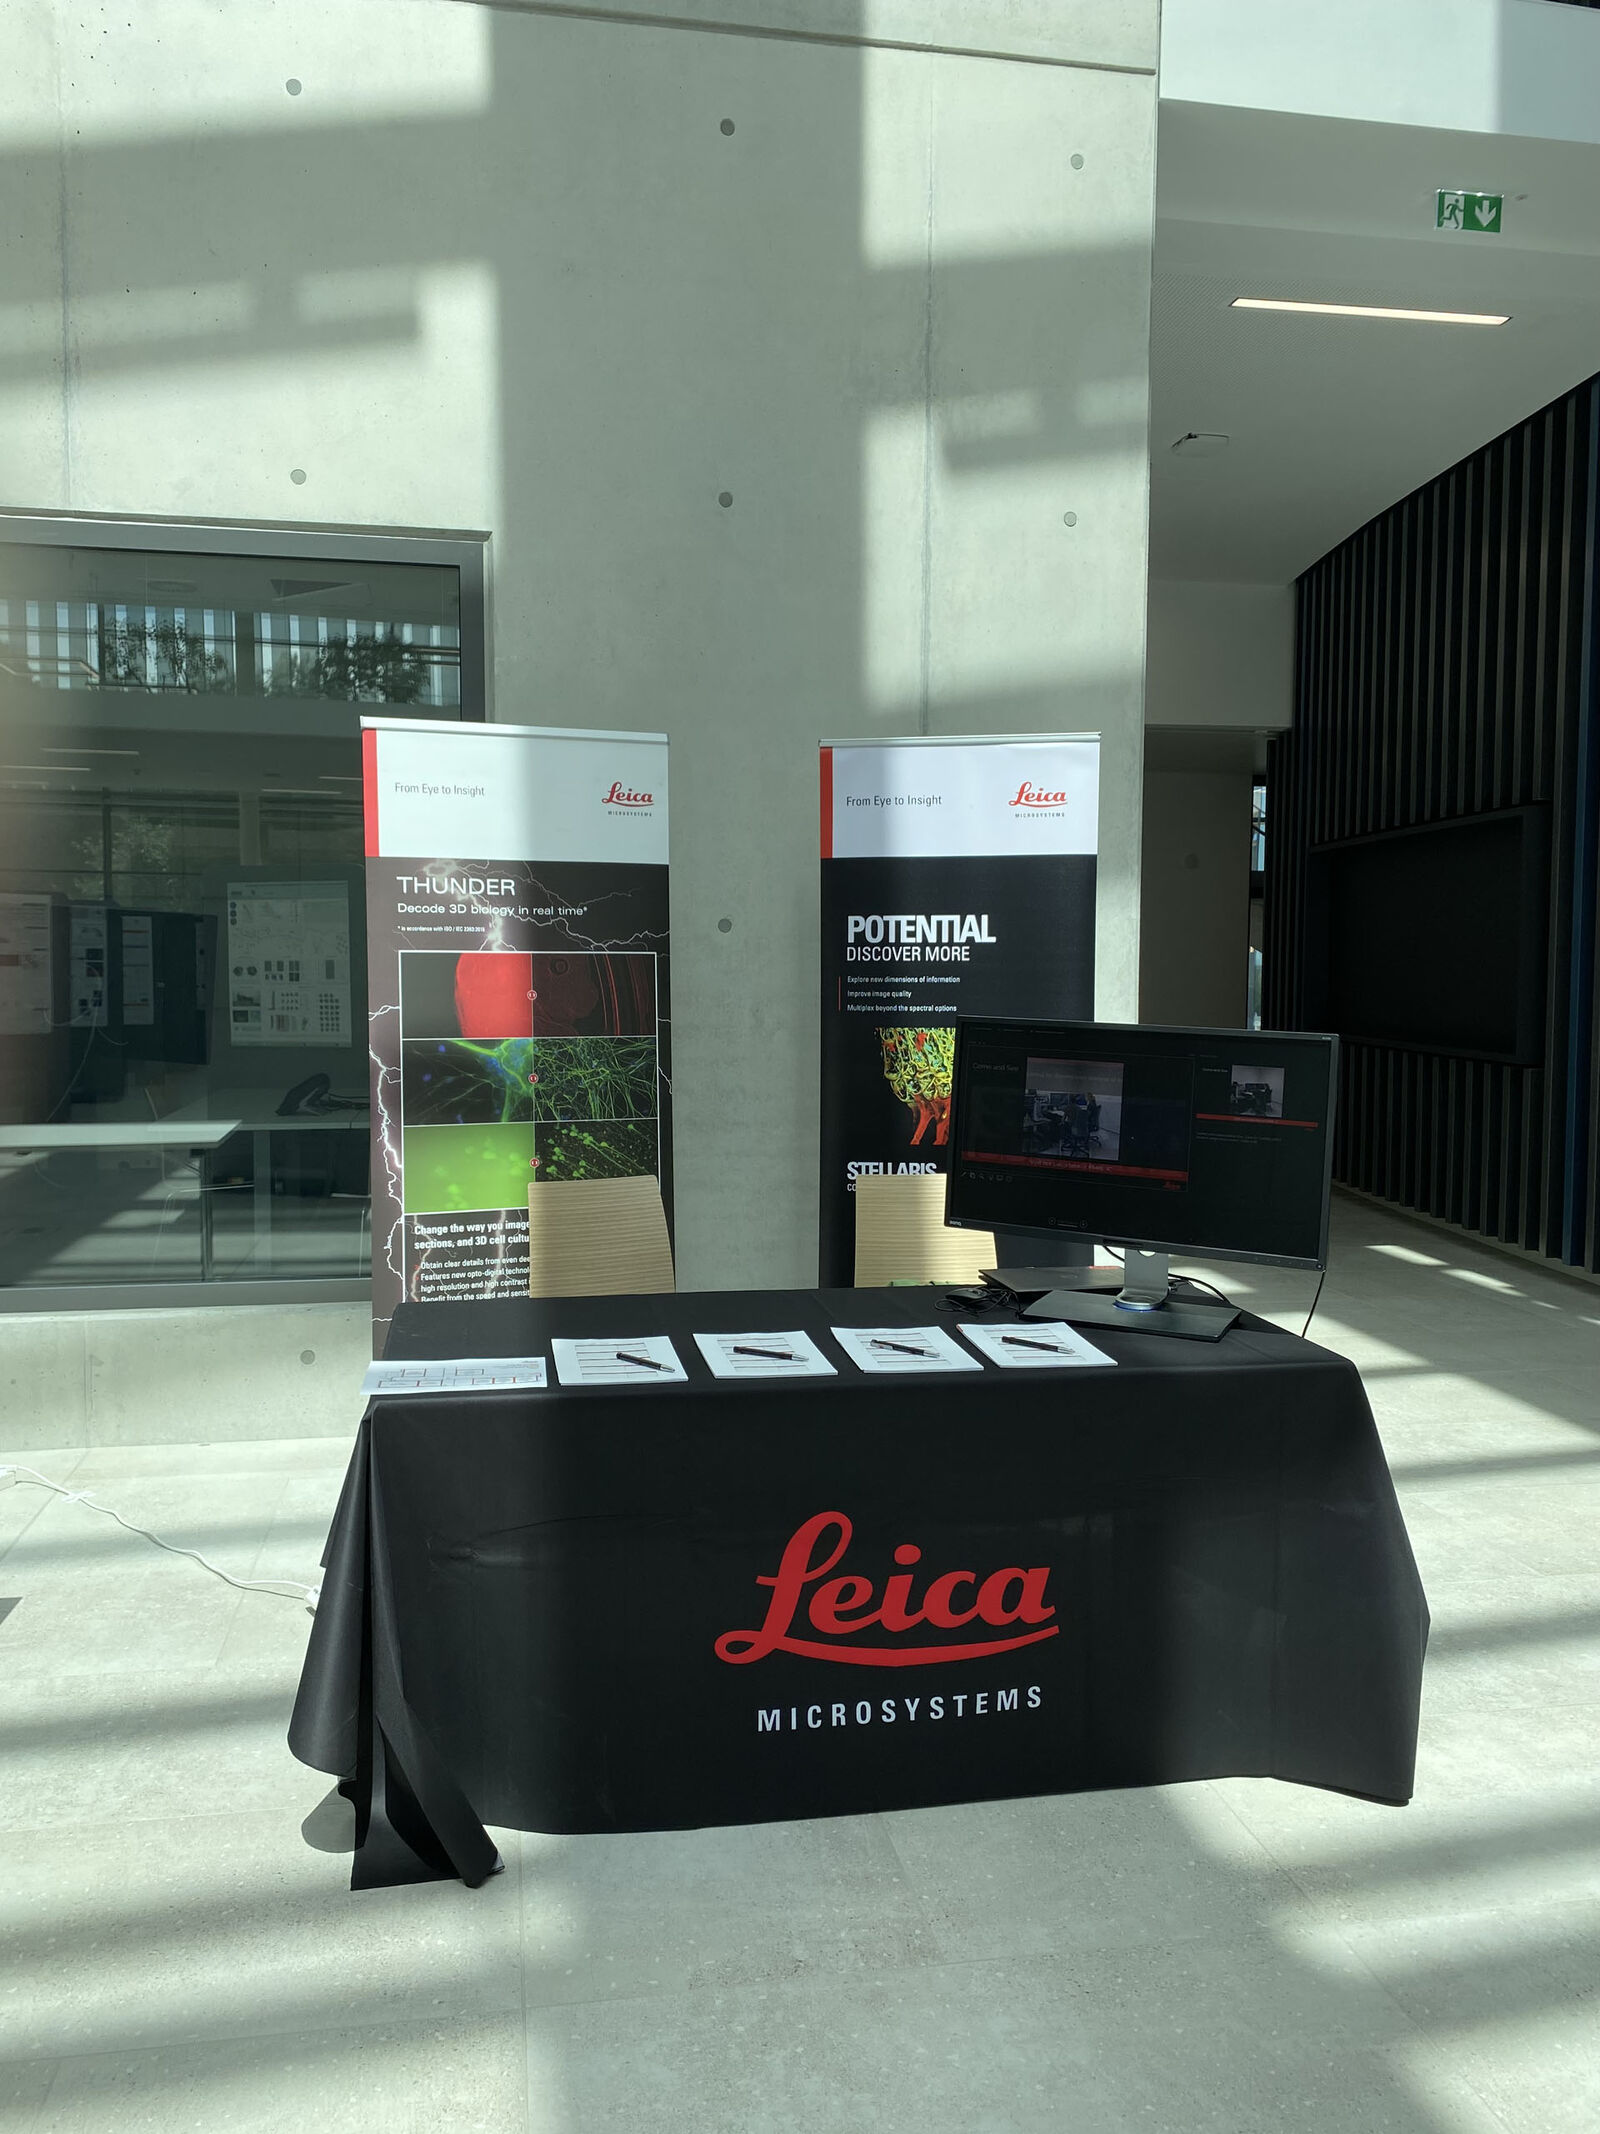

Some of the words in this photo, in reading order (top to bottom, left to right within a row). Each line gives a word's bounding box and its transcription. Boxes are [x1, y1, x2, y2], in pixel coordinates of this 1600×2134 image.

[395, 782, 419, 793] From
[422, 783, 439, 796] Eye
[441, 785, 451, 794] to
[454, 785, 485, 797] Insight
[602, 781, 654, 807] Leica
[1008, 781, 1068, 808] Leica
[846, 796, 871, 806] From
[873, 795, 892, 807] Eye
[895, 796, 904, 805] to
[907, 795, 942, 807] Insight
[396, 876, 516, 896] THUNDER
[398, 903, 445, 913] Decode
[449, 904, 467, 914] 3D
[471, 904, 515, 917] biology
[518, 905, 529, 915] in
[532, 905, 554, 915] real
[847, 914, 997, 944] POTENTIAL
[847, 945, 921, 962] DISCOVER
[925, 945, 970, 961] MORE
[872, 990, 890, 998] image
[891, 990, 912, 998] quality
[847, 1161, 937, 1180] STELLARIS
[414, 1225, 448, 1236] Change
[450, 1223, 464, 1233] the
[466, 1224, 486, 1233] way
[487, 1223, 503, 1233] you
[505, 1220, 530, 1230] image
[414, 1239, 455, 1250] sections,
[457, 1237, 473, 1247] and
[475, 1236, 487, 1245] 3D
[489, 1235, 505, 1244] cell
[421, 1261, 443, 1270] Obtain
[444, 1260, 461, 1268] clear
[462, 1258, 484, 1267] details
[420, 1273, 450, 1281] Features
[467, 1269, 504, 1278] opto-digital
[505, 1267, 530, 1275] technol
[420, 1285, 436, 1294] high
[437, 1282, 470, 1292] resolution
[471, 1281, 484, 1289] and
[484, 1280, 499, 1289] high
[500, 1278, 527, 1287] contrast
[476, 1291, 496, 1300] speed
[497, 1290, 510, 1298] and
[714, 1510, 1060, 1667] Leica
[757, 1685, 1042, 1732] MICROSYSTEMS
